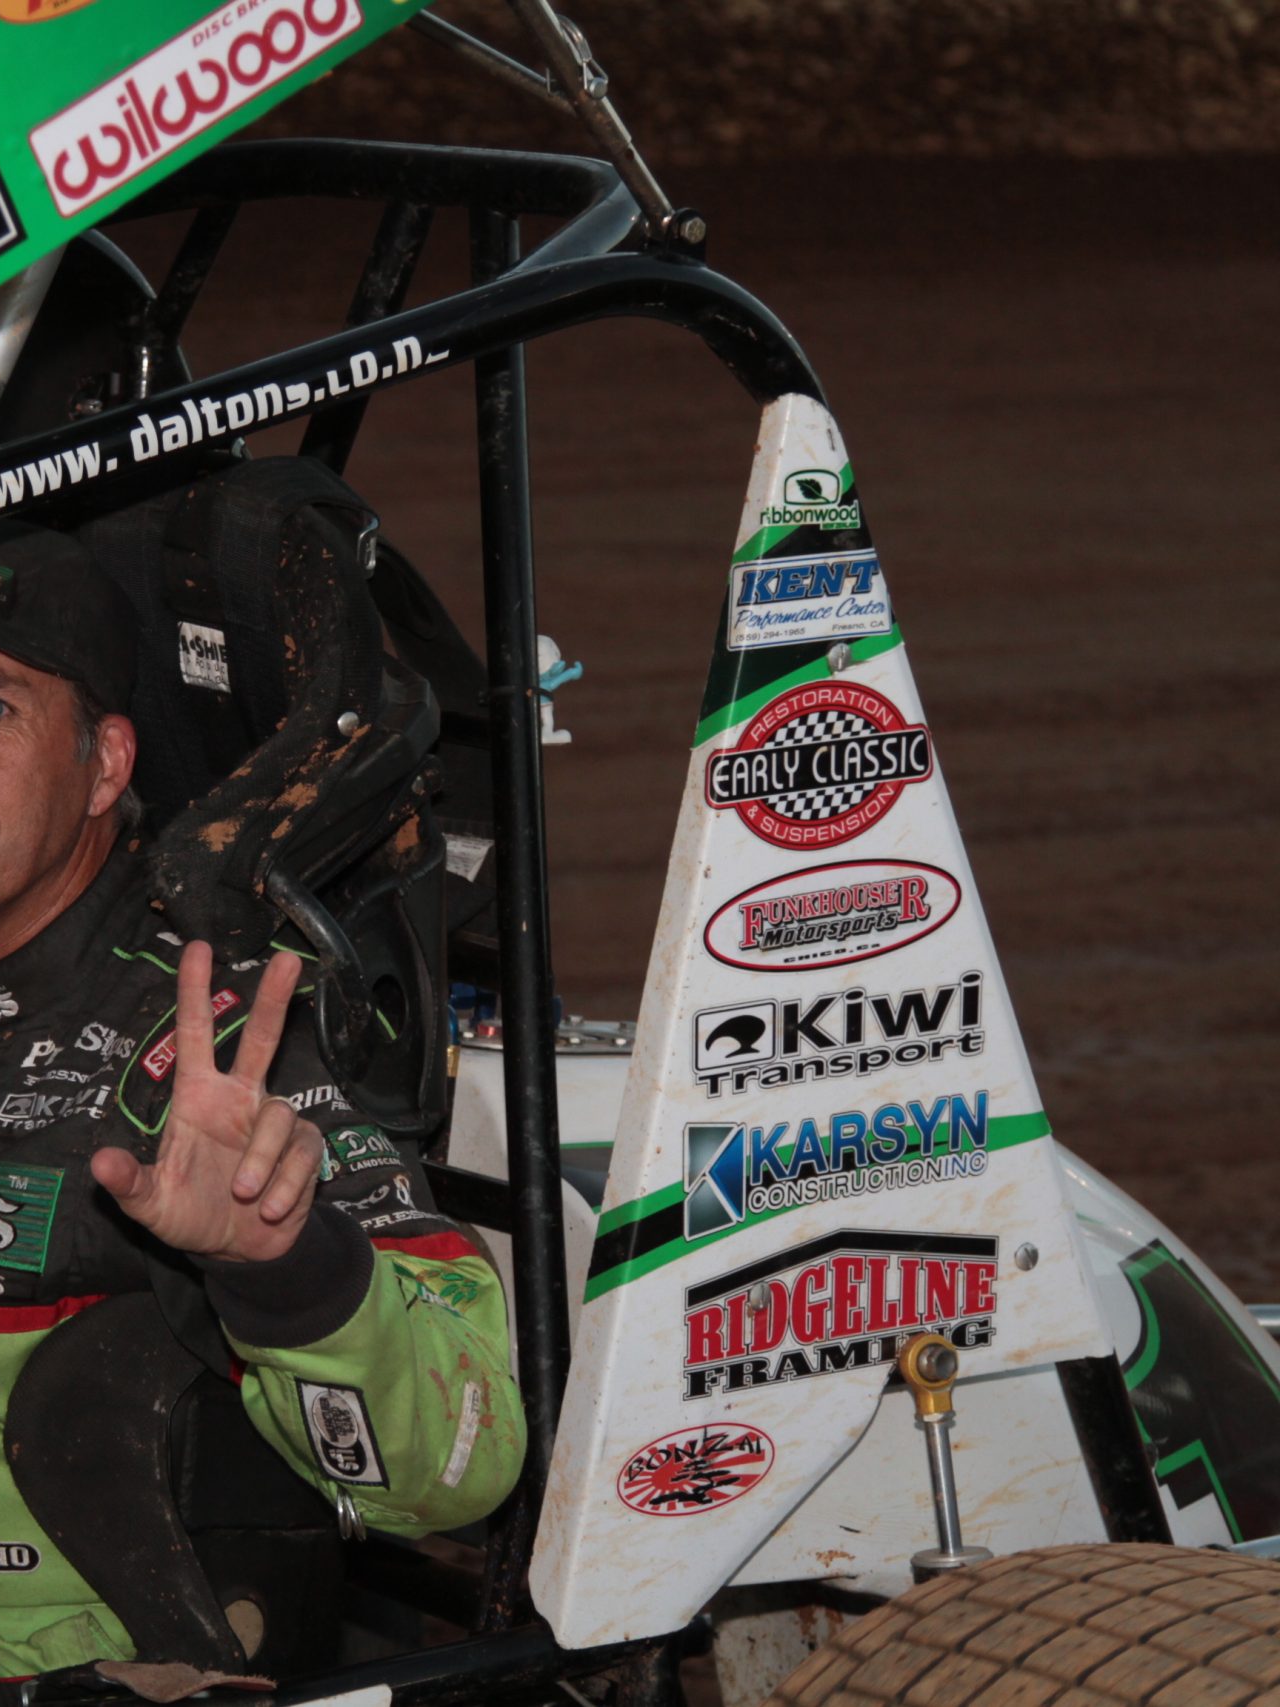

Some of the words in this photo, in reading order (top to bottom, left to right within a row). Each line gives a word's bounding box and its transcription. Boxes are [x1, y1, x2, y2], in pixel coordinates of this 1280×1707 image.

[191, 11, 233, 48] DISC
[760, 500, 859, 525] ribbonwood
[737, 558, 881, 607] KENT
[734, 606, 833, 630] Performance
[835, 597, 887, 619] Center
[870, 620, 885, 629] CA
[750, 689, 894, 742] RESTORATION
[712, 749, 800, 798] EARLY
[812, 734, 925, 783] CLASSIC
[747, 805, 759, 820] &
[760, 785, 895, 843] SUSPENSION
[739, 875, 931, 949] FUNKHOUSER
[761, 909, 898, 949] Motorsports
[782, 971, 984, 1056] Kiwi
[697, 1032, 985, 1098] Transport
[749, 1090, 989, 1186] KARSYN
[685, 1254, 998, 1366] RIDGELINE
[683, 1316, 997, 1401] FRAMIG
[627, 1425, 763, 1482] BONZAI
